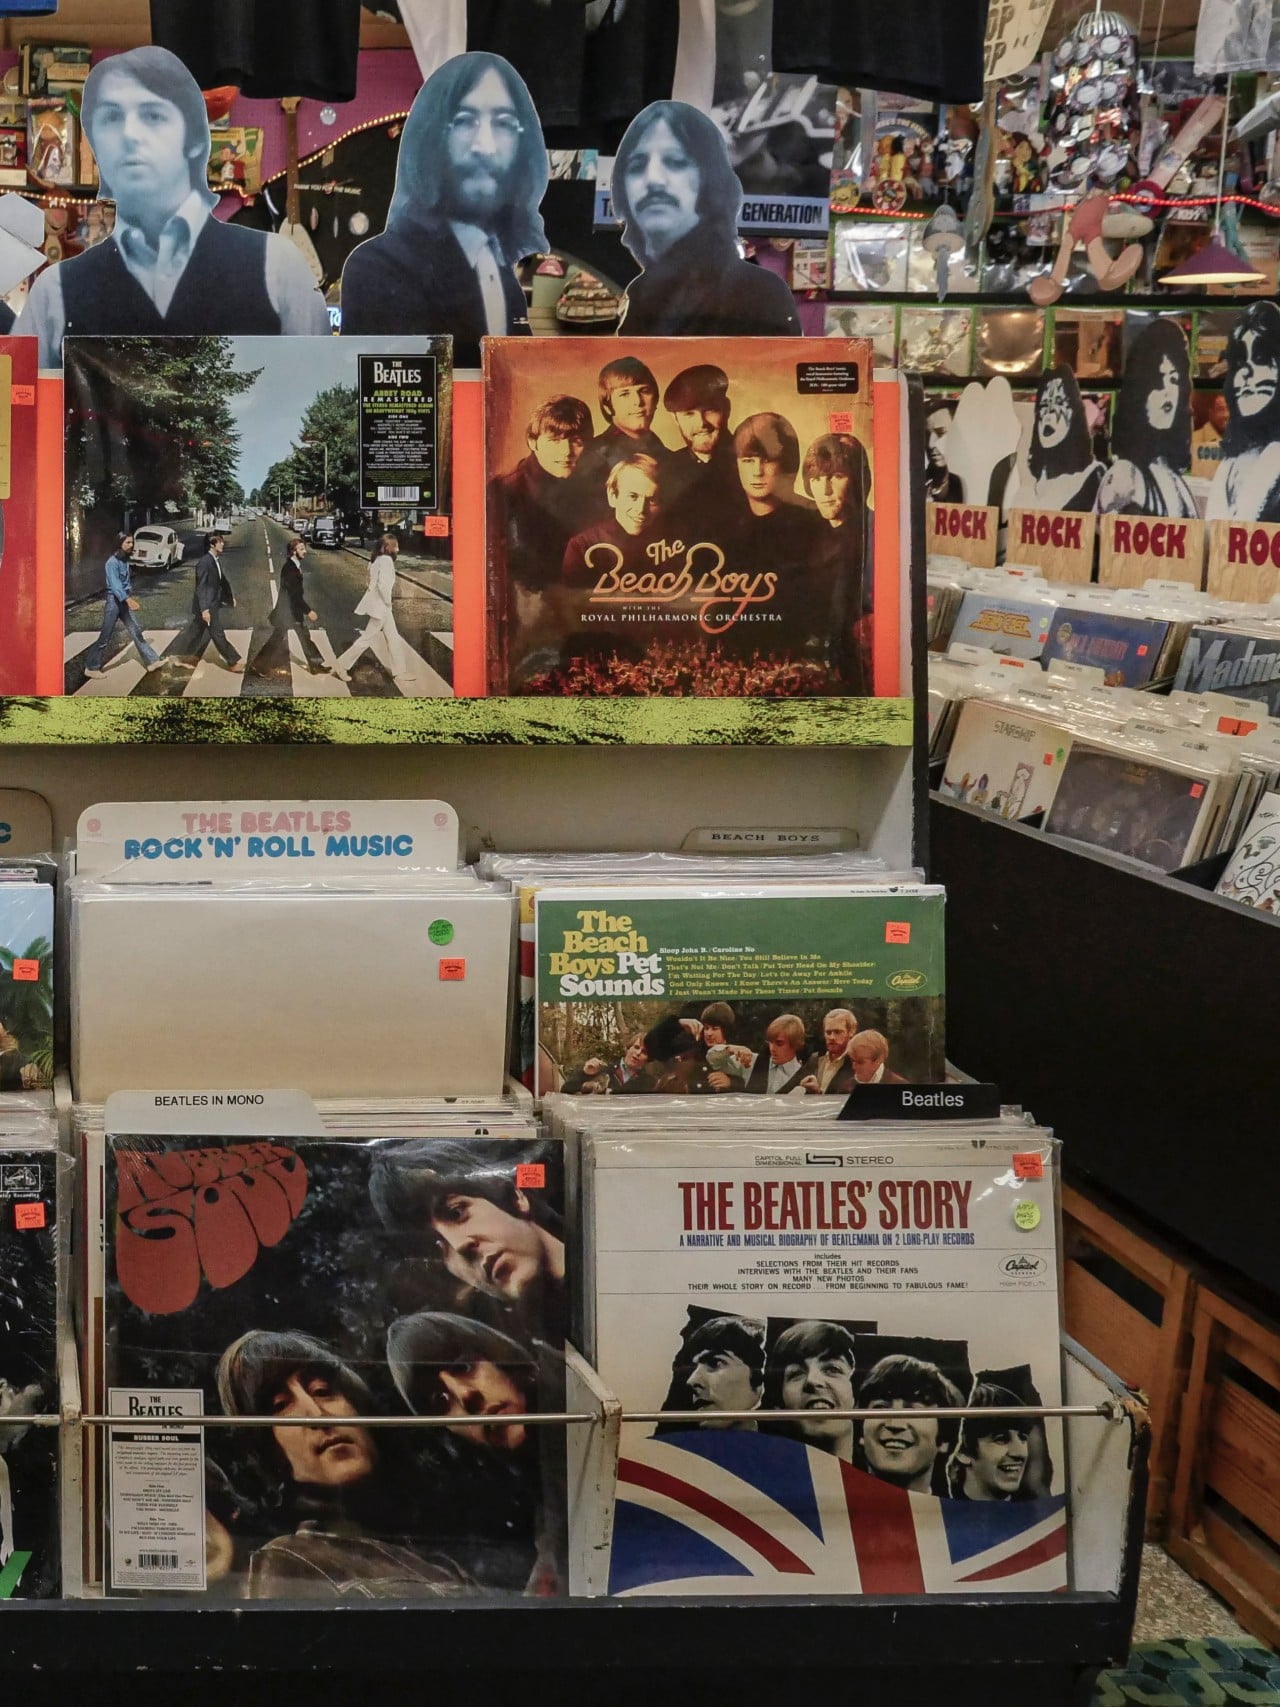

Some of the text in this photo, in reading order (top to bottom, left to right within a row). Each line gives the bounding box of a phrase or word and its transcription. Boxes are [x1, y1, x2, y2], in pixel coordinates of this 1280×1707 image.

[742, 203, 823, 224] GENERATION
[374, 361, 421, 387] BEATLES
[935, 508, 987, 540] ROCK
[1021, 513, 1082, 550] ROCK
[1114, 520, 1187, 559] ROCK
[647, 540, 685, 566] The
[584, 542, 693, 601] Beach
[581, 613, 783, 623] ROYAL PHILHARMONIC ORCHESTRA
[993, 720, 1036, 742] STARSHIP
[1232, 721, 1242, 735] J
[182, 811, 352, 834] THE BEATLES
[125, 835, 413, 860] ROCK 'N' ROLL MUSIC
[711, 833, 820, 842] BEACH BOYS
[577, 910, 633, 934] The
[563, 931, 648, 954] Beach
[549, 952, 662, 977] Boys Pet
[559, 975, 665, 997] Sounds
[155, 1094, 264, 1106] BEATLES IN MONO
[902, 1090, 964, 1107] Beatles
[678, 1180, 972, 1232] THE BEATLES' STORY
[116, 1155, 308, 1314] SOUL
[680, 1233, 975, 1246] A NARRATIVE AND MUSICAL BIOGRAPHY OF BEATLEMANIA ON 2 LONG-PLAY RECORDS
[1005, 1259, 1039, 1271] Capitol
